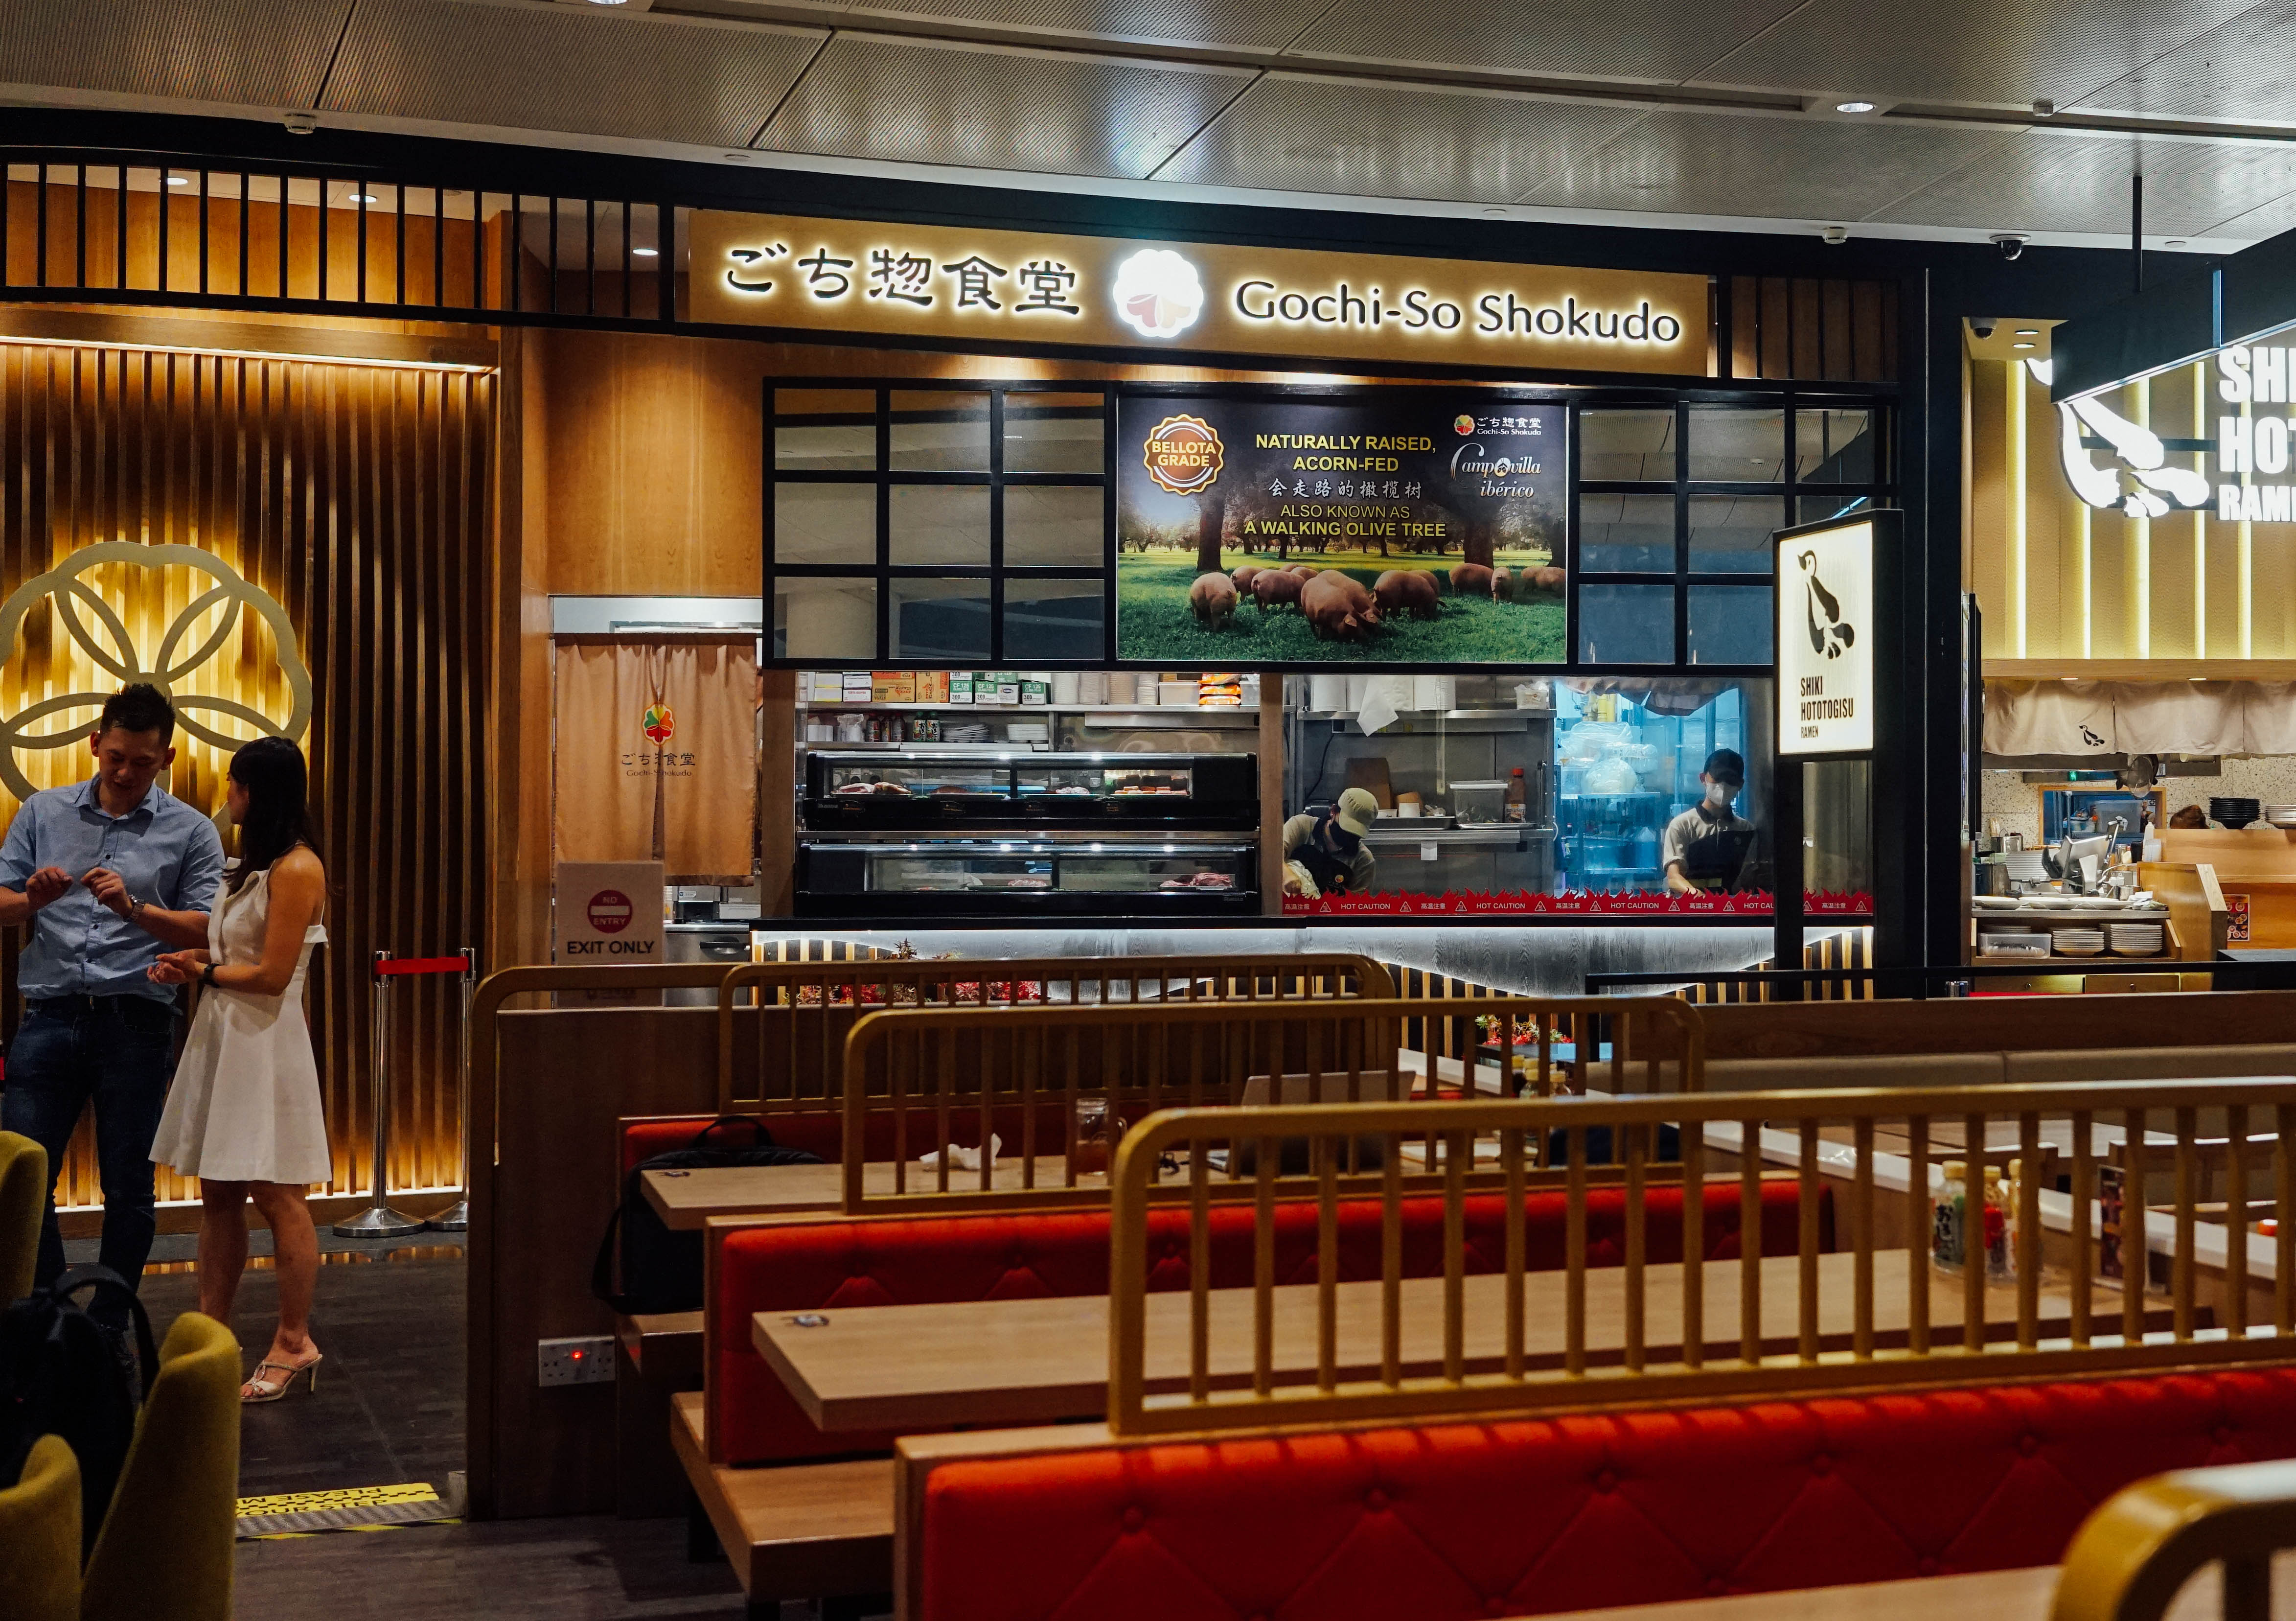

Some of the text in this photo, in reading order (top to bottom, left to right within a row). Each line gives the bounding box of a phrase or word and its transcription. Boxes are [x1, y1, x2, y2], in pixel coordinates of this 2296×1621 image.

[727, 243, 1079, 315] ごち惣食堂
[1236, 280, 1680, 342] Gochi-So Shokudo
[1477, 417, 1541, 428] ごち惣食堂
[1152, 441, 1217, 454] BELLOTA
[1256, 434, 1436, 453] NATURALLY RAISED,
[1157, 454, 1210, 467] GRADE
[1293, 456, 1399, 471] ACORN-FED
[1268, 478, 1422, 499] 会走路的橄榄树
[1480, 480, 1535, 498] ibérico
[2219, 485, 2296, 522] RAM
[1280, 505, 1410, 519] ALSO KNOWN AS
[1244, 521, 1446, 537] A WALKING OLIVE TREE
[1801, 675, 1823, 697] SHIKI
[1801, 697, 1853, 721] HOTOTOGISU
[1801, 725, 1818, 739] RAMEN
[567, 940, 655, 954] EXIT ONLY
[276, 1488, 381, 1501] PLEASE
[320, 1499, 387, 1509] STEP
